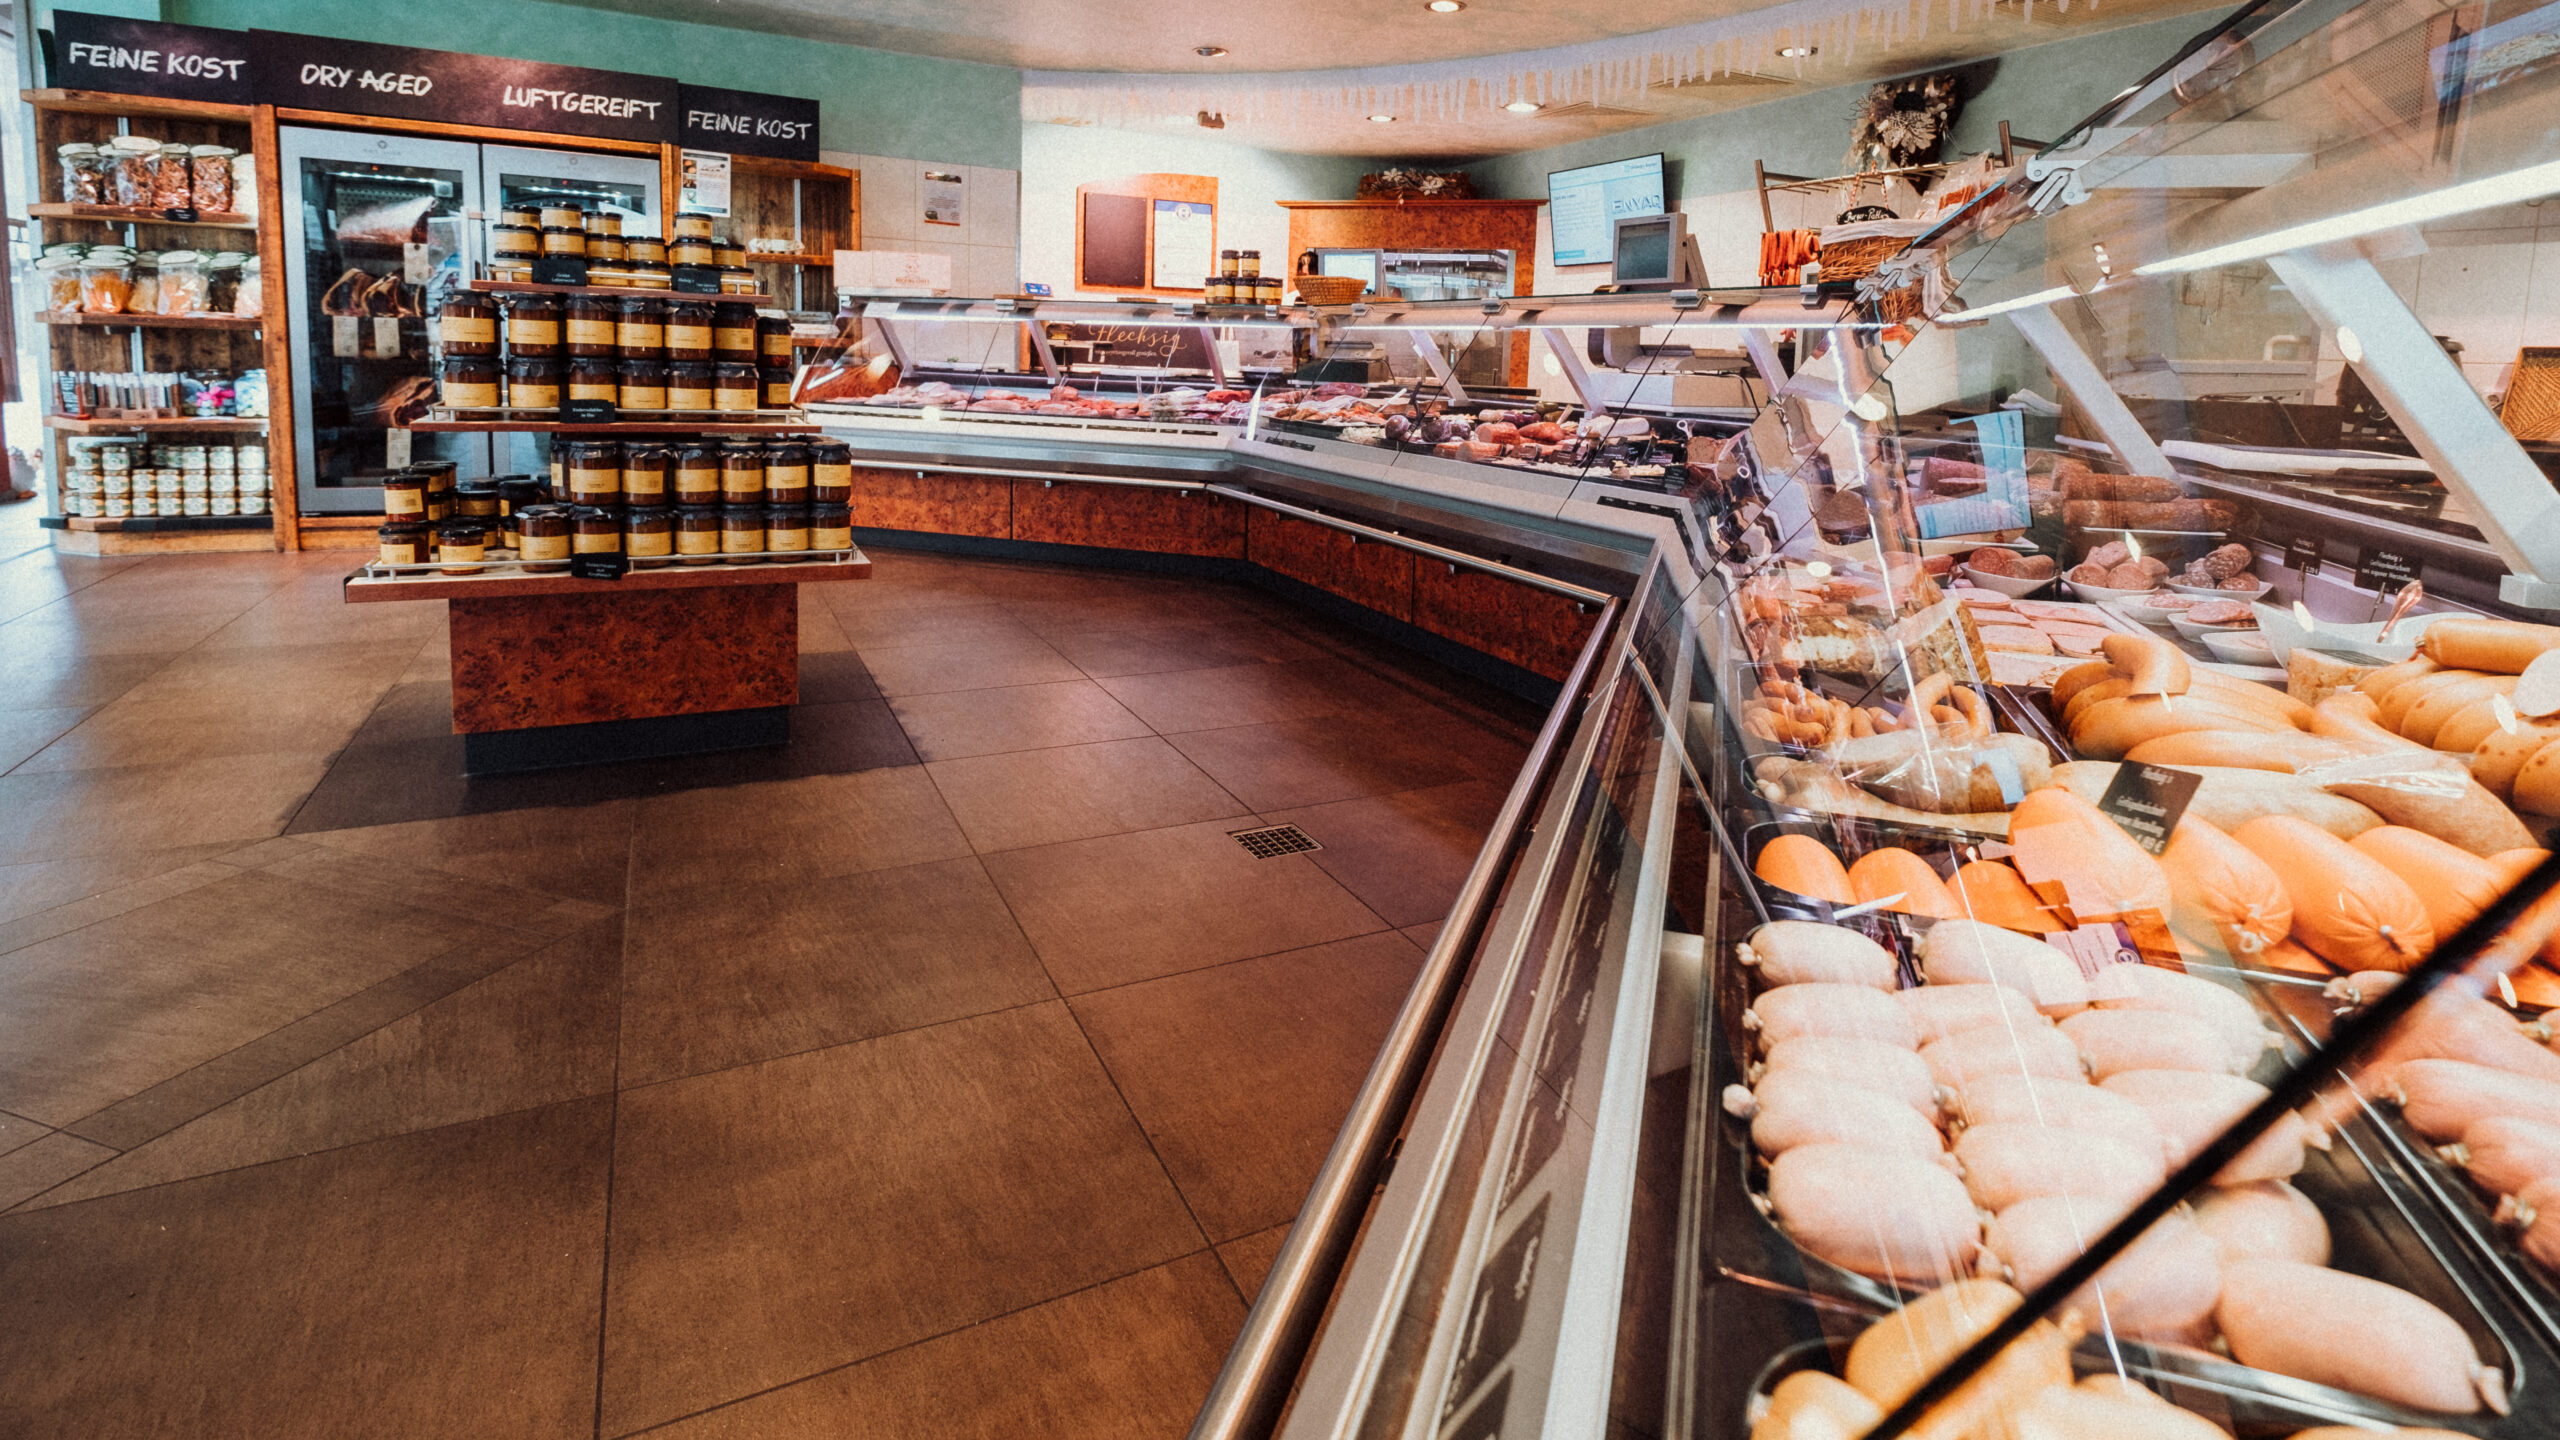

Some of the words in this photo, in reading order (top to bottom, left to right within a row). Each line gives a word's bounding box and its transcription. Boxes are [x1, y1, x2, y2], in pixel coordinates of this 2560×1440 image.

[69, 42, 161, 73] FEINE
[167, 53, 246, 81] KOST
[301, 64, 353, 88] DRY
[358, 70, 433, 97] AGED
[503, 85, 662, 120] LUFTGEREIFT
[688, 110, 751, 135] FEINE
[756, 118, 812, 141] KOST
